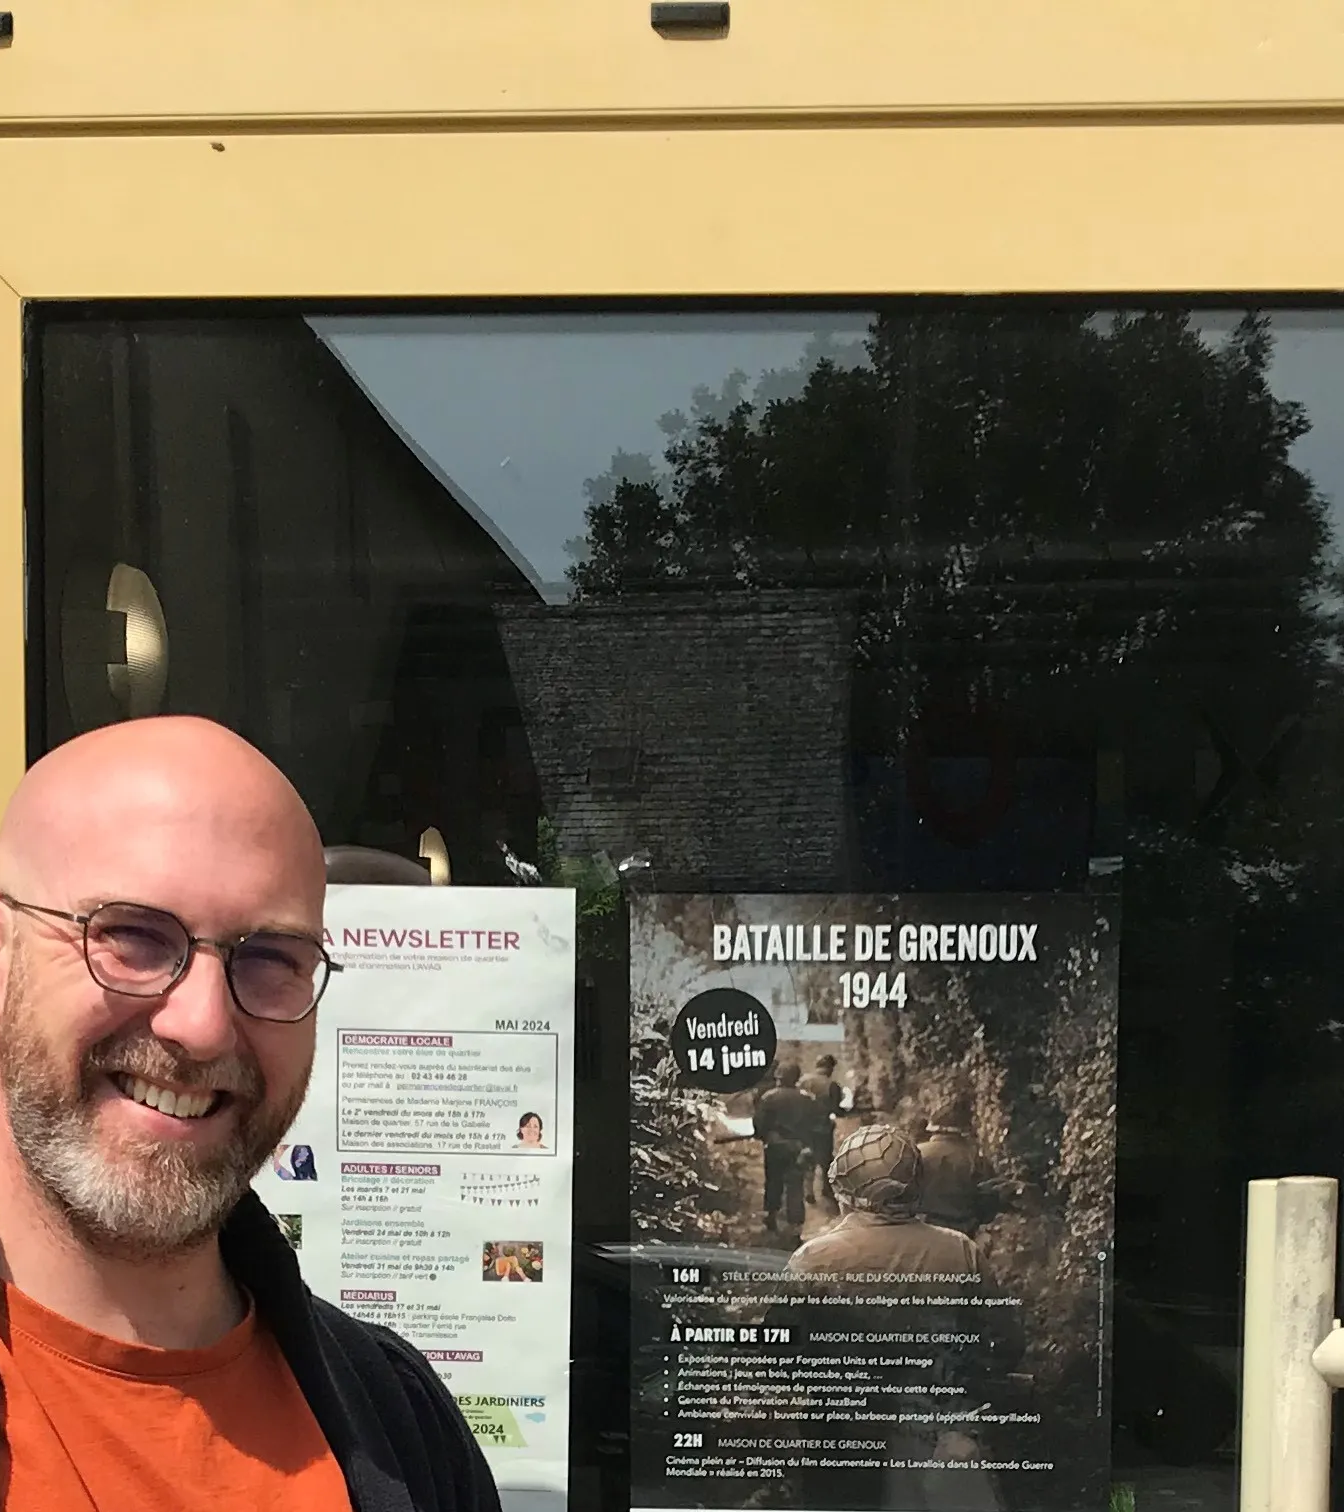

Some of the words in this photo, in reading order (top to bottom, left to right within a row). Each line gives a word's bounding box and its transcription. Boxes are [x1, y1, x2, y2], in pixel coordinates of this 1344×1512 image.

[343, 929, 520, 950] NEWSLETTER
[713, 924, 846, 961] BATAILLE
[855, 925, 891, 960] DE
[899, 925, 1037, 961] GRENOUX
[839, 972, 907, 1008] 1944
[495, 1020, 518, 1030] MAI
[522, 1021, 550, 1031] 2024
[686, 1011, 759, 1040] Vendredi
[410, 1036, 450, 1046] LOCALE
[687, 1047, 715, 1072] 14
[721, 1045, 766, 1076] juin
[343, 1164, 388, 1174] ADULTES
[395, 1166, 438, 1175] SENIORS
[673, 1268, 700, 1283] 16H
[846, 1272, 864, 1282] RUE
[867, 1273, 881, 1283] DU
[883, 1273, 931, 1283] SOUVENIR
[933, 1273, 981, 1285] FRANÇAIS
[717, 1294, 729, 1303] du
[731, 1295, 758, 1305] projet
[790, 1296, 805, 1306] par
[927, 1296, 968, 1305] habitants
[971, 1296, 983, 1305] du
[670, 1323, 681, 1342] À
[685, 1328, 735, 1342] PARTIR
[740, 1328, 757, 1342] DE
[764, 1328, 790, 1342] 17H
[810, 1333, 848, 1342] MAISON
[851, 1333, 864, 1342] DE
[866, 1333, 914, 1342] QUARTIER
[916, 1333, 929, 1342] DE
[931, 1333, 980, 1343] GRENOUX
[678, 1354, 728, 1365] Expositions
[730, 1355, 777, 1366] proposées
[779, 1357, 794, 1366] par
[796, 1356, 841, 1366] Forgotten
[880, 1357, 903, 1365] Laval
[905, 1357, 933, 1368] Image
[678, 1368, 728, 1377] Animations
[475, 1396, 545, 1407] JARDINIERS
[678, 1396, 718, 1405] Concerts
[720, 1396, 731, 1405] du
[733, 1396, 788, 1405] Preservation
[678, 1409, 721, 1419] Ambiance
[774, 1411, 808, 1420] buvette
[855, 1412, 897, 1421] barbecue
[899, 1412, 934, 1423] partagé
[982, 1414, 998, 1422] vos
[472, 1424, 504, 1434] 2024
[673, 1433, 703, 1447] 22H
[718, 1438, 756, 1447] MAISON
[759, 1439, 772, 1448] DE
[773, 1439, 821, 1449] QUARTIER
[823, 1439, 836, 1448] DE
[838, 1440, 886, 1449] GRENOUX
[666, 1456, 699, 1465] Cinéma
[702, 1456, 724, 1467] plein
[746, 1456, 785, 1466] Diffusion
[787, 1457, 800, 1466] du
[801, 1457, 818, 1466] film
[890, 1459, 905, 1468] Les
[907, 1459, 945, 1468] Lavallois
[947, 1460, 968, 1468] dans
[971, 1460, 978, 1468] la
[980, 1460, 1019, 1470] Seconde
[1022, 1461, 1053, 1470] Guerre
[666, 1467, 707, 1477] Mondiale
[716, 1468, 745, 1477] réalisé
